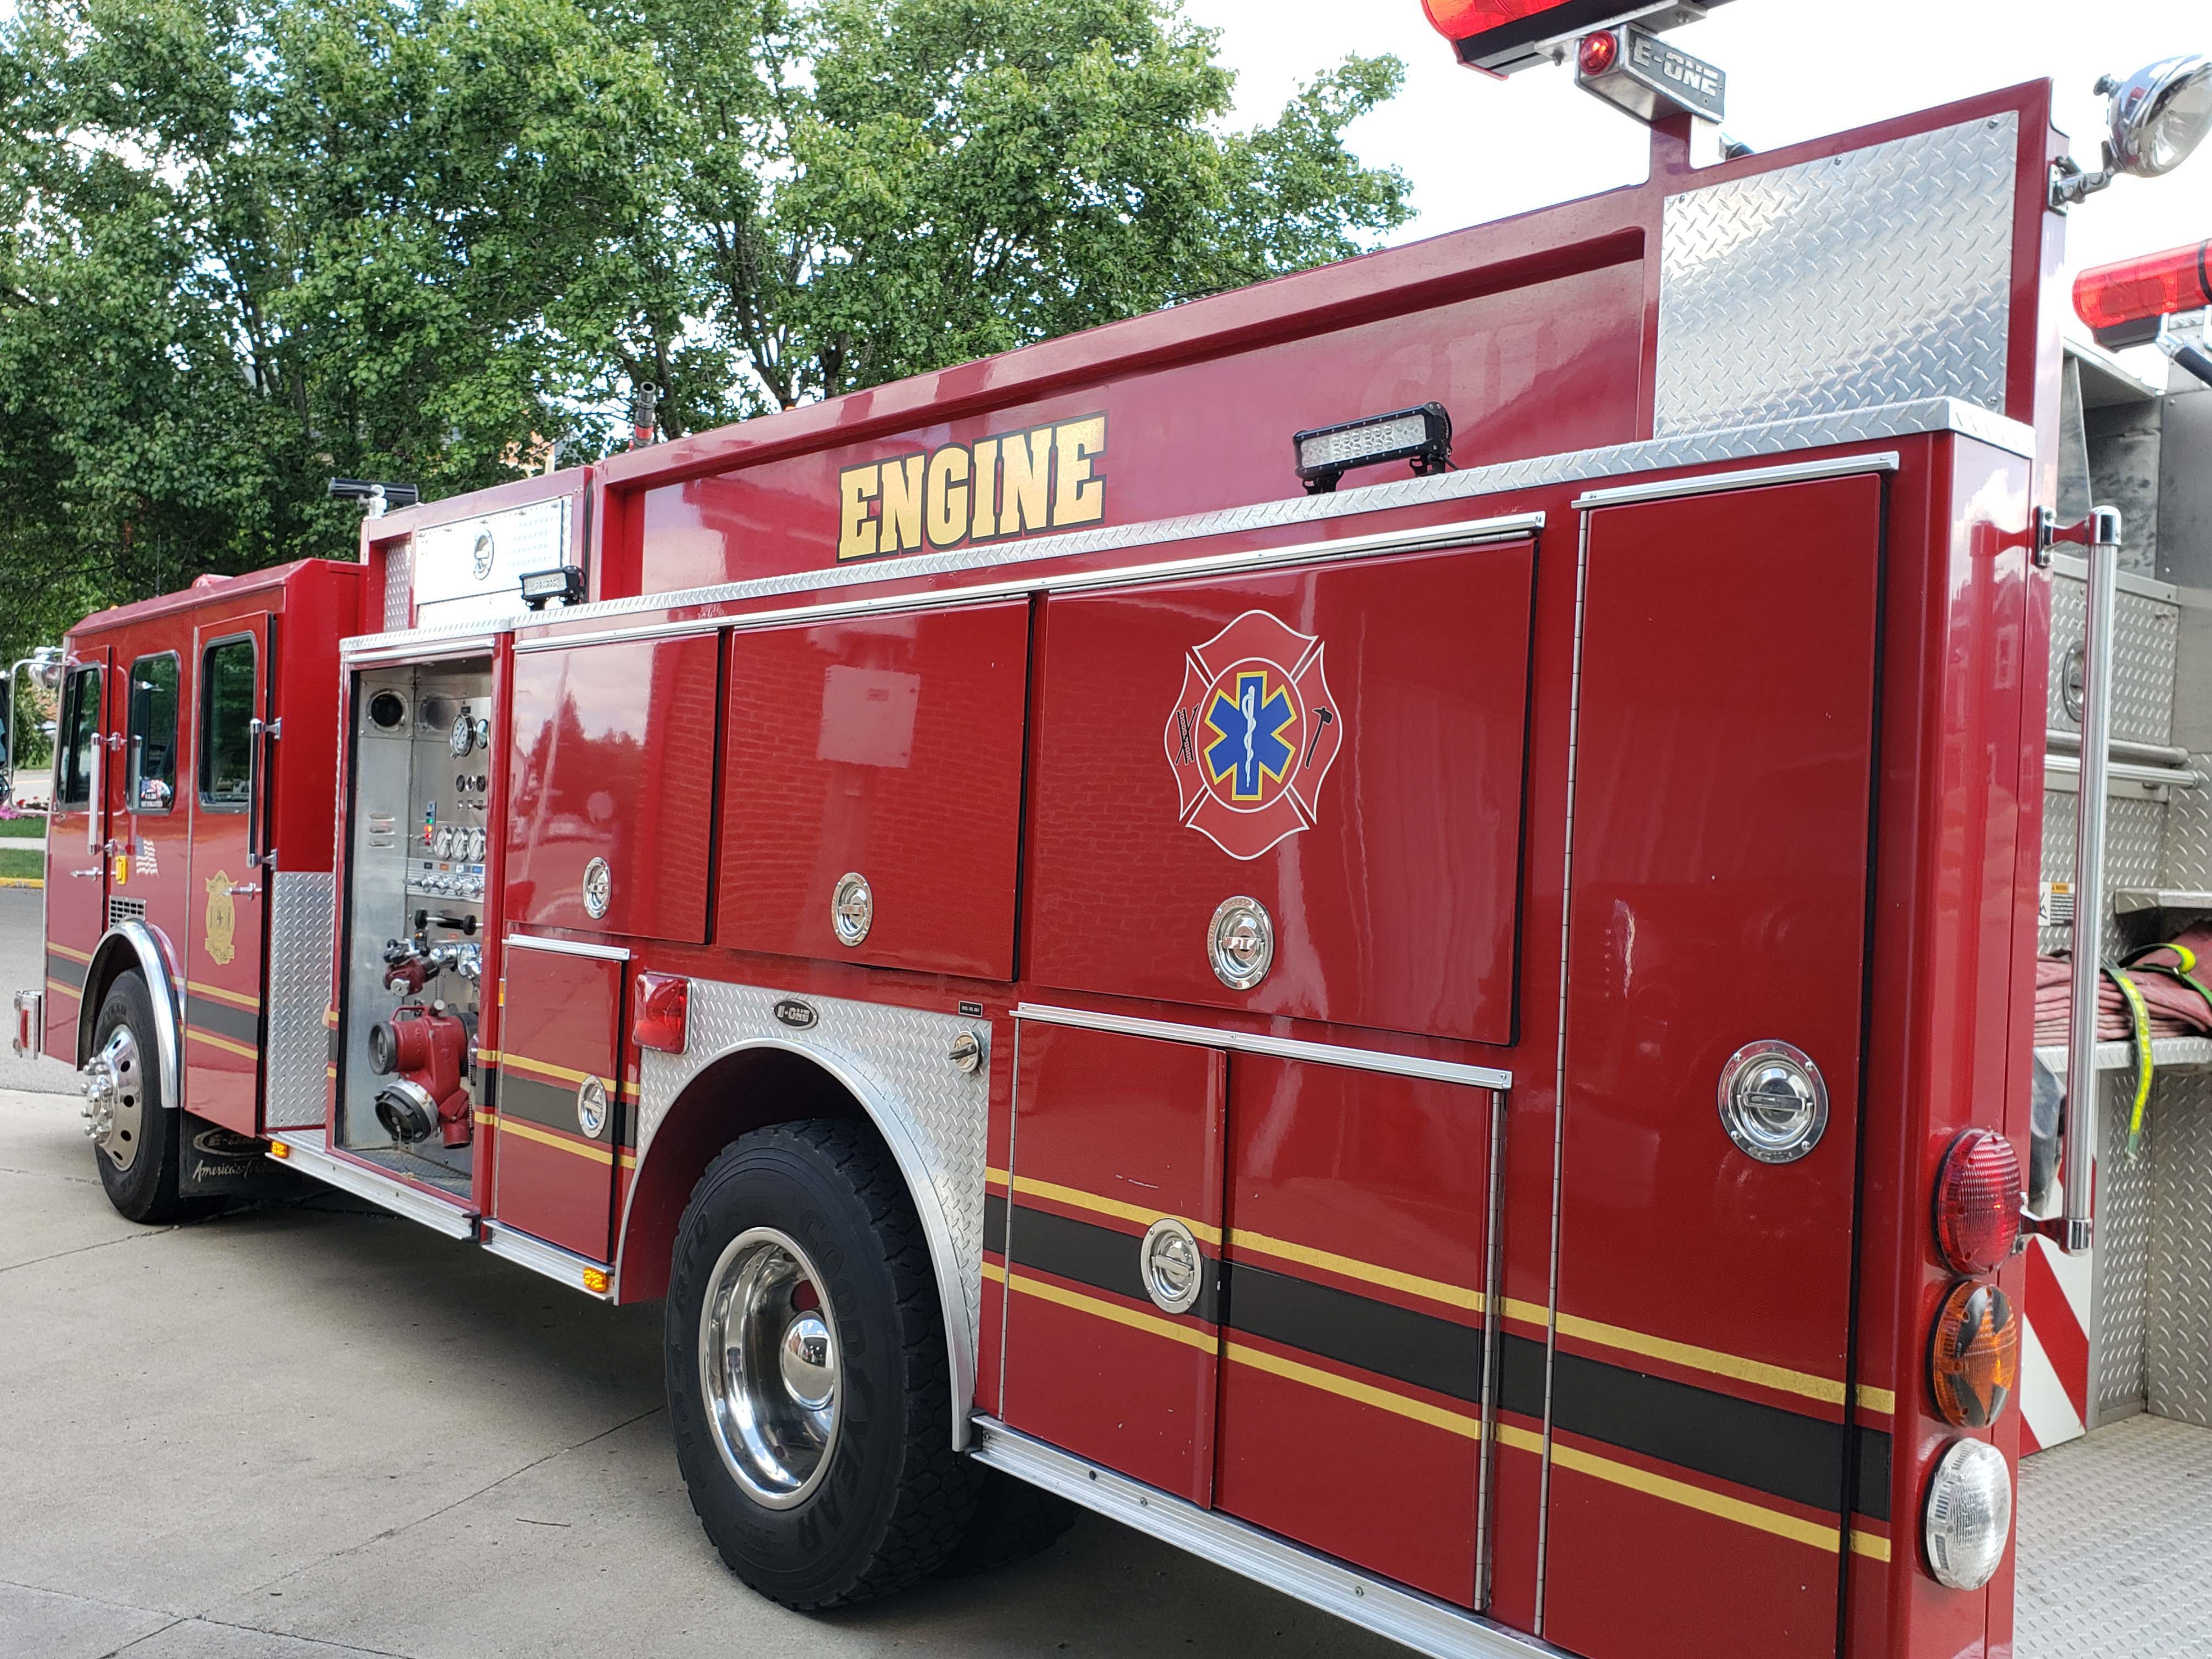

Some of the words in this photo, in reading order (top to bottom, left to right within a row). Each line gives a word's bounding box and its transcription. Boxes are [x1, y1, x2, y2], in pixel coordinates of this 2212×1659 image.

[1633, 37, 1719, 97] E-ONE
[837, 412, 1108, 562] ENGINE
[192, 1159, 243, 1183] America's
